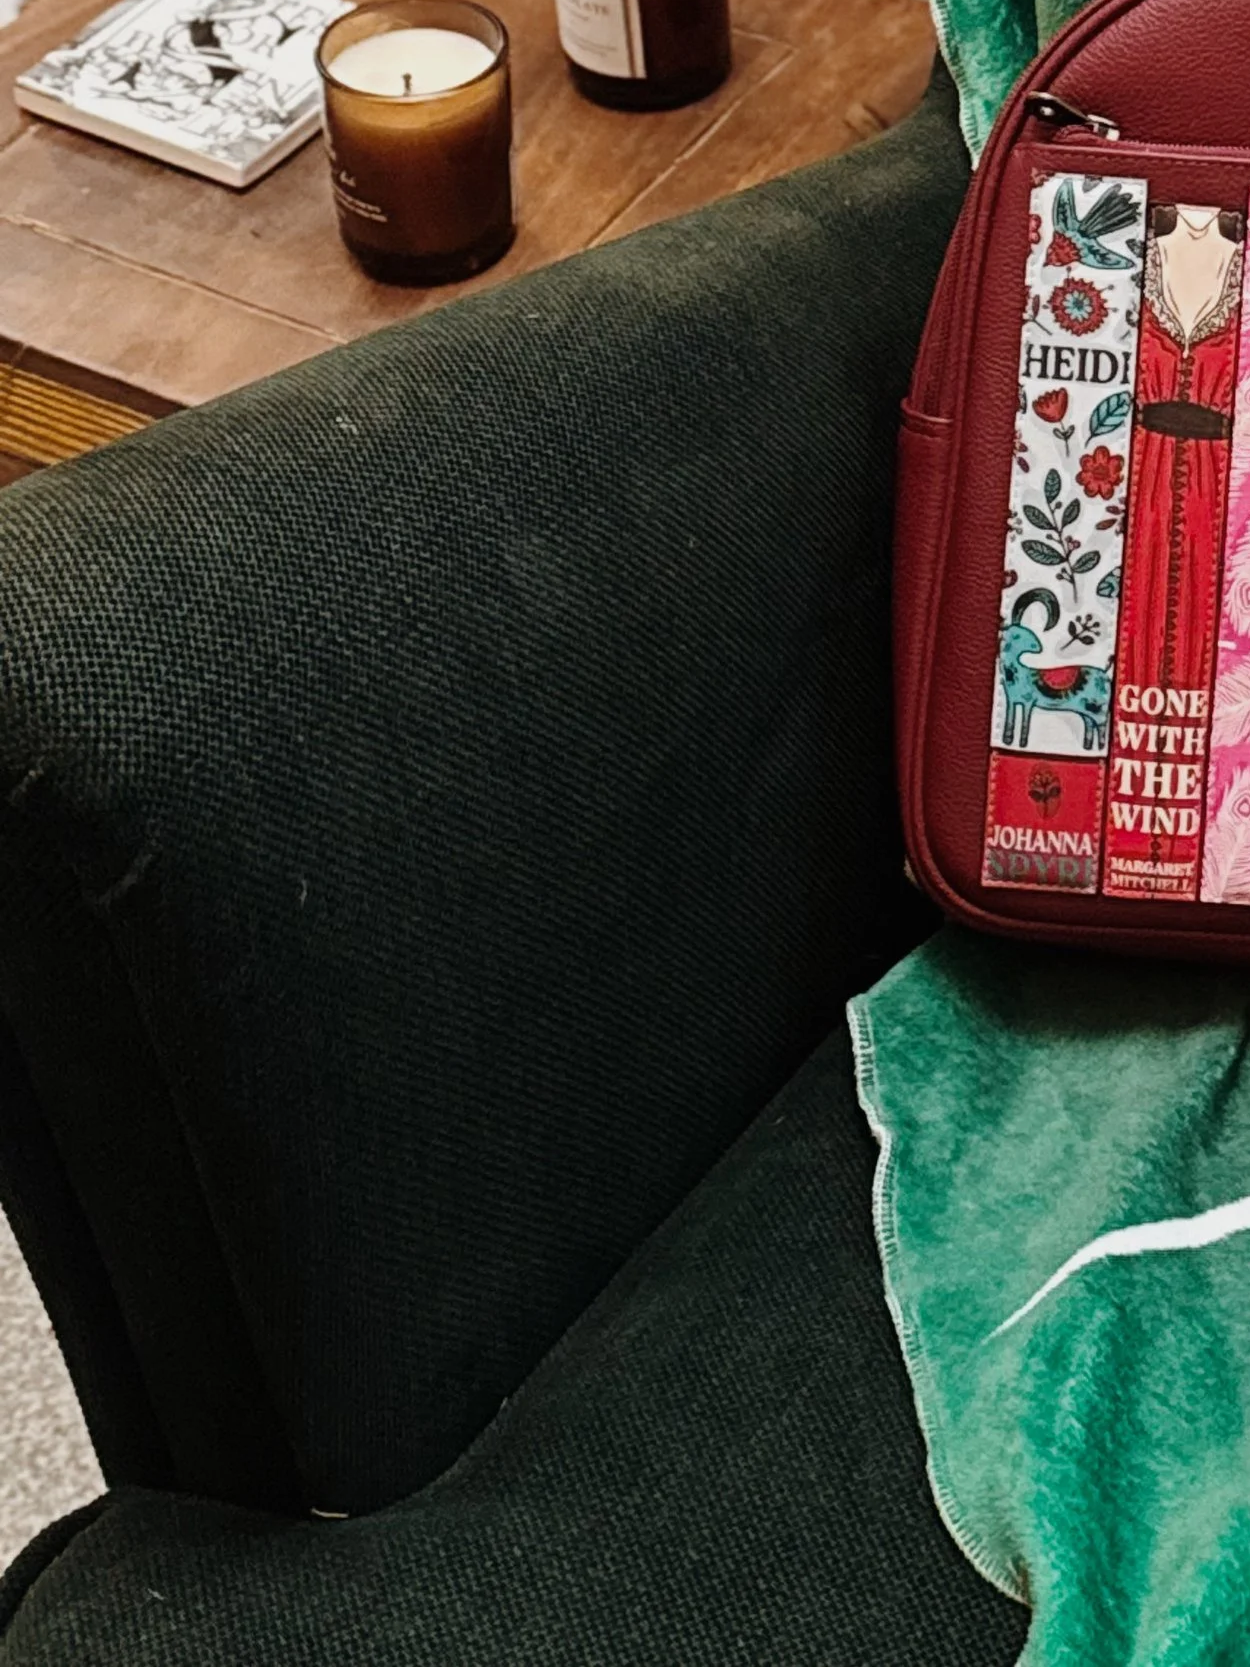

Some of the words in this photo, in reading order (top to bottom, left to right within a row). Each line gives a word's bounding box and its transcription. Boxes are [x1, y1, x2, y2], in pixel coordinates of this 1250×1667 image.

[1022, 343, 1132, 385] HEIDI
[1119, 684, 1208, 718] GONE
[1117, 720, 1206, 756] WITH
[1114, 758, 1201, 800] THE
[1110, 801, 1200, 836] WIND
[987, 824, 1093, 856] JOHANNA
[988, 849, 1094, 887] SPYRI
[1110, 856, 1195, 878] MARGARET
[1110, 872, 1192, 891] MITCHELL
